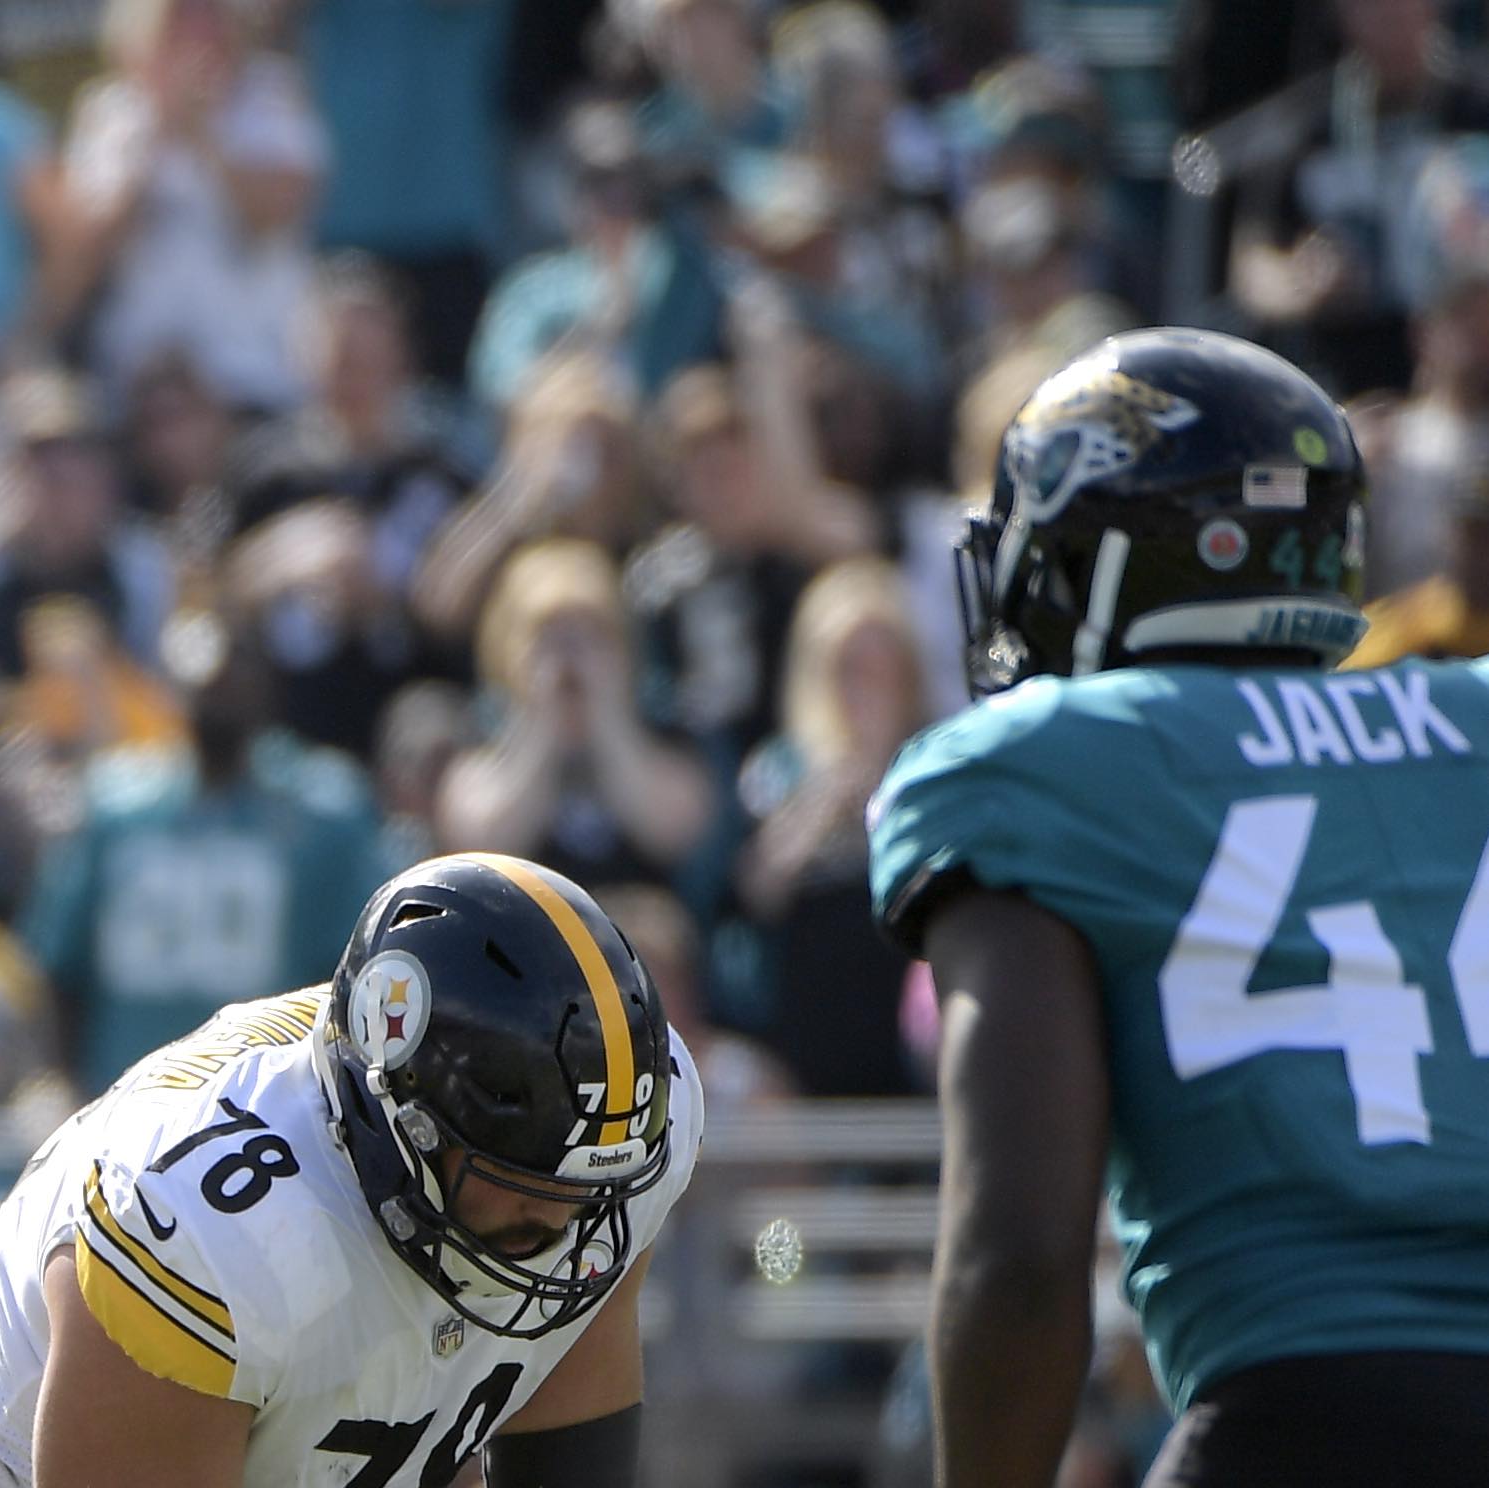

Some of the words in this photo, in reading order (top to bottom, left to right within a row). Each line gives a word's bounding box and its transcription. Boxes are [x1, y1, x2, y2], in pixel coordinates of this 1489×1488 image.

[1234, 670, 1472, 767] JACK
[1158, 794, 1489, 1147] 4
[564, 1065, 654, 1146] 78
[144, 1096, 301, 1214] 78
[587, 1150, 633, 1168] Steelers
